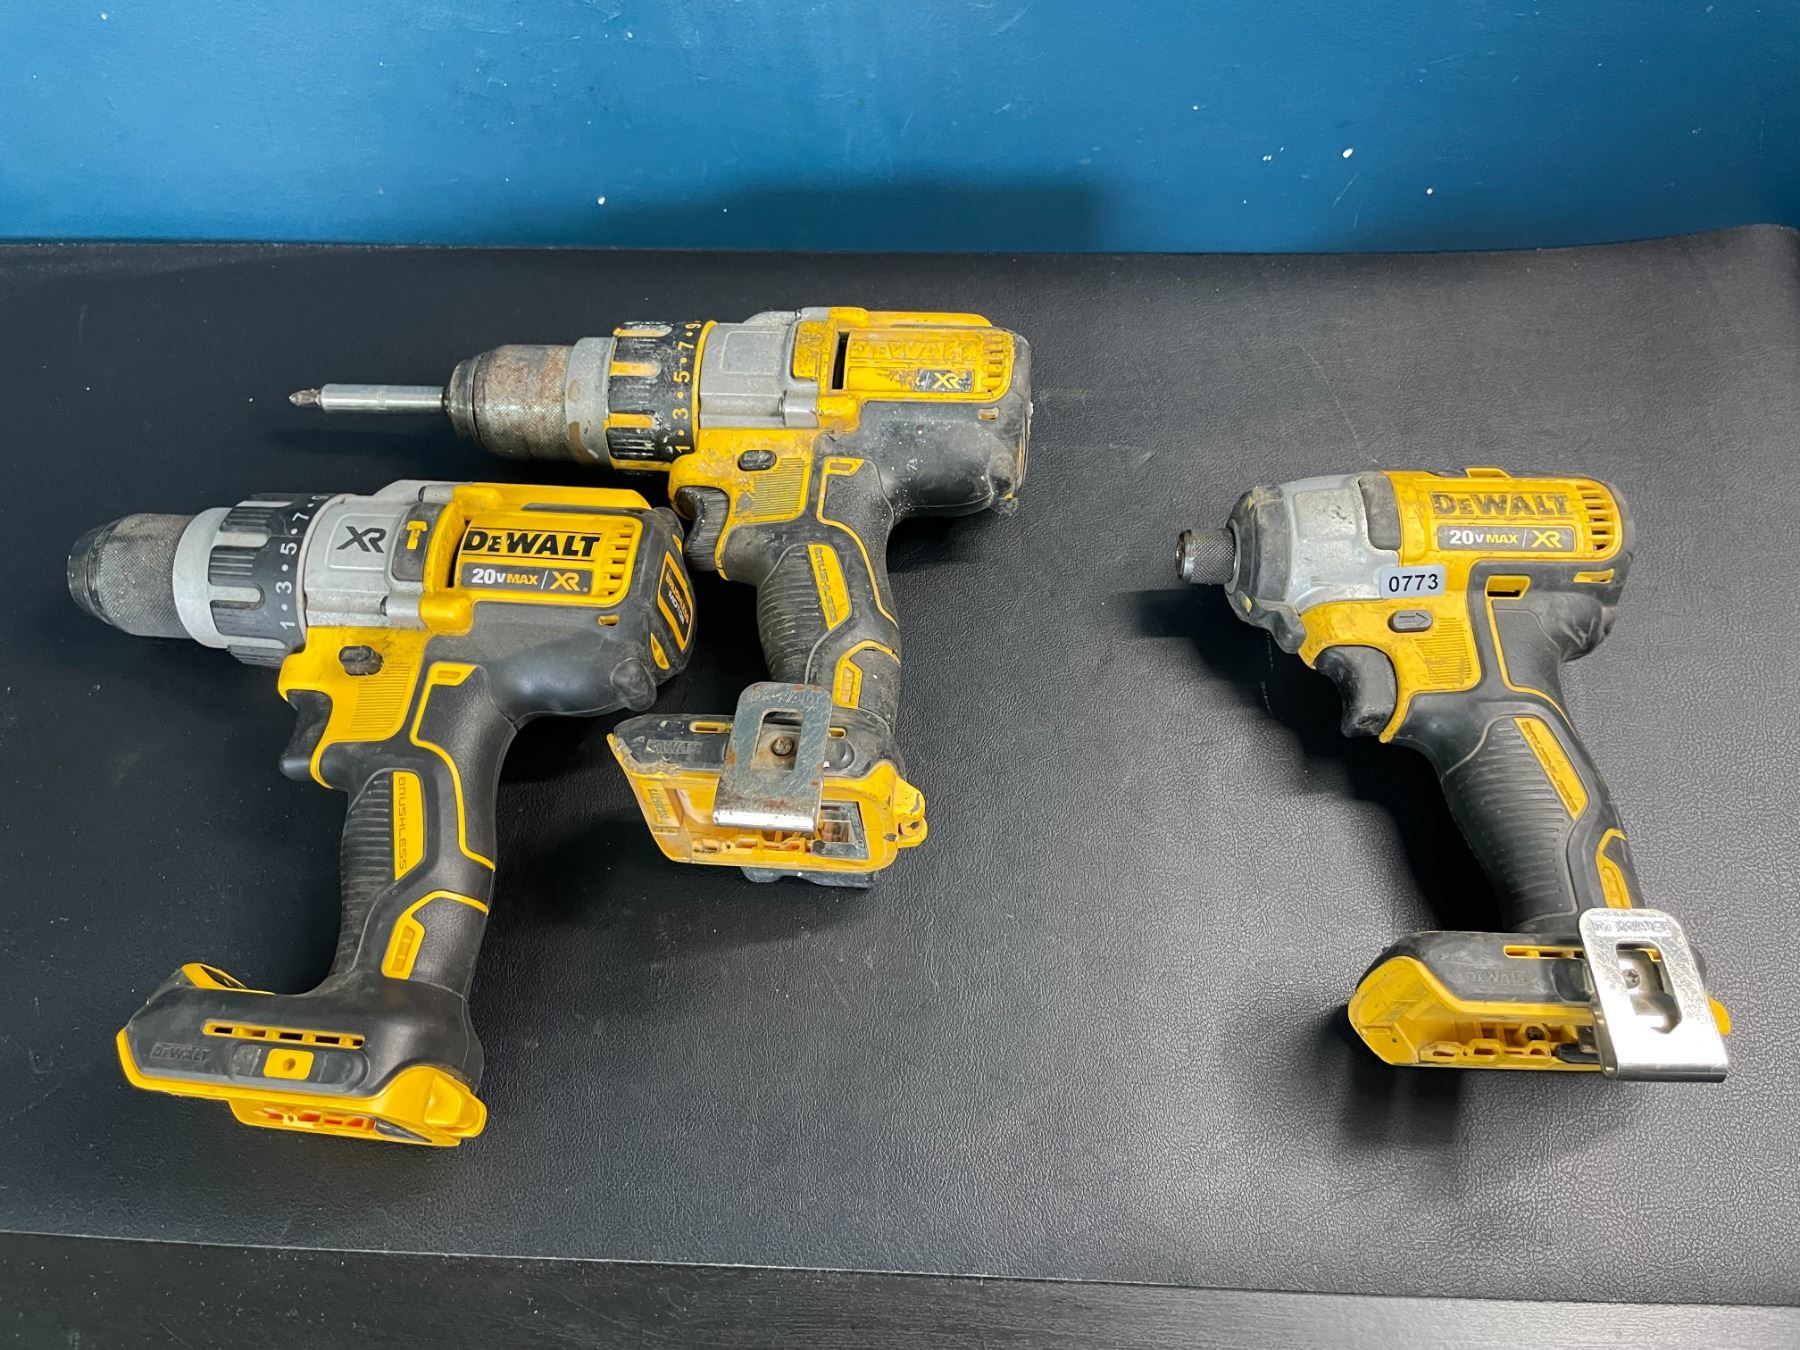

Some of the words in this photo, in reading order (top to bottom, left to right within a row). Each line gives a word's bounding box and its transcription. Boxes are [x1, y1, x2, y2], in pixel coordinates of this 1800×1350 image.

[678, 341, 695, 351] 7
[673, 370, 690, 383] 5
[931, 372, 961, 389] XR
[672, 407, 689, 420] 3
[675, 445, 691, 453] 1
[1431, 492, 1568, 516] DEWALT
[292, 512, 309, 521] 7
[336, 525, 387, 554] XR
[462, 530, 600, 558] DEWALT
[1531, 530, 1562, 548] XR
[280, 542, 298, 555] 5
[275, 581, 293, 594] 3
[550, 571, 581, 592] XR
[1388, 573, 1439, 593] 0773
[280, 621, 295, 630] 1
[398, 776, 408, 871] BRUSHLESS
